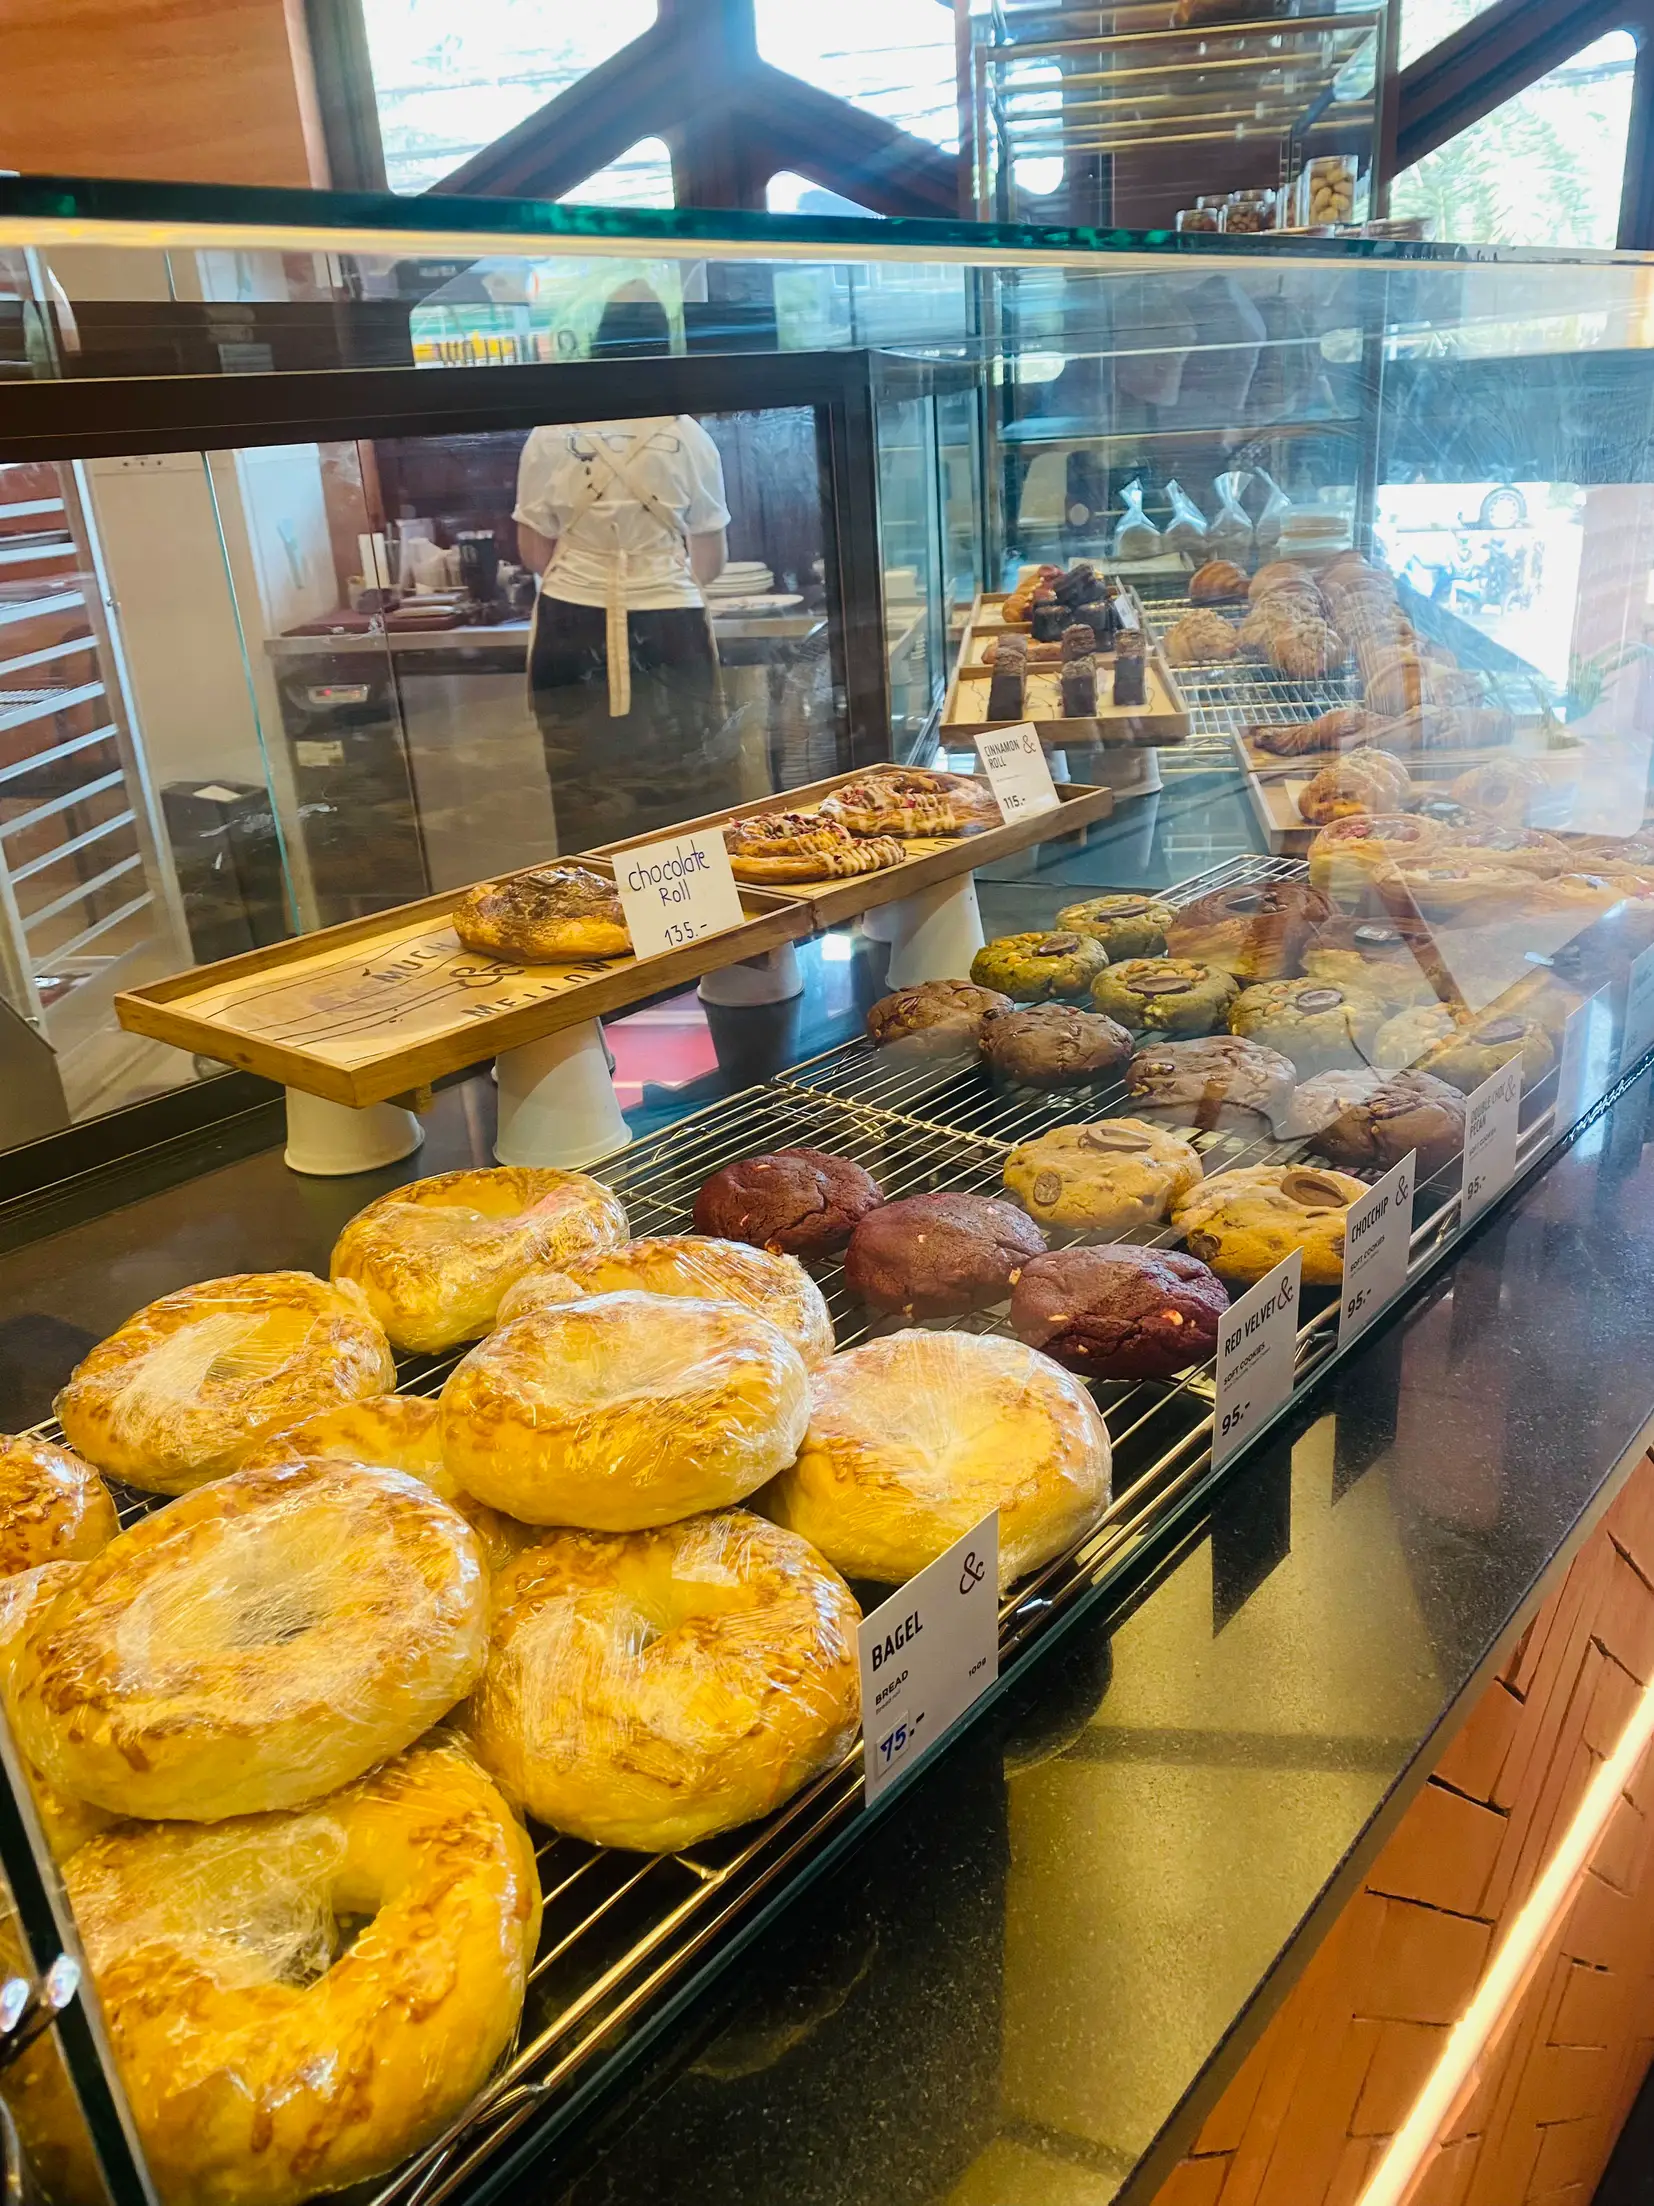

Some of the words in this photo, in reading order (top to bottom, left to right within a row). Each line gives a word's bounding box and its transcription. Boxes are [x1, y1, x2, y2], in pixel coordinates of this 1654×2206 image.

[984, 739, 1020, 757] CINNAMON
[1022, 735, 1037, 754] &
[989, 756, 1007, 770] ROLL
[1003, 795, 1026, 809] 115.-
[659, 879, 691, 907] Roll
[371, 942, 457, 983] MUCH
[1394, 1175, 1409, 1207] &
[1351, 1196, 1389, 1244] CHOCCHIP
[1277, 1275, 1293, 1312] &
[1347, 1288, 1372, 1319] 95.-
[1224, 1327, 1242, 1358] RED
[1245, 1296, 1276, 1337] VELVET
[1224, 1365, 1239, 1386] SOFT
[1240, 1341, 1265, 1370] COOKIES
[1222, 1401, 1250, 1436] 95.-
[959, 1551, 985, 1595] &
[872, 1610, 923, 1672] BAGEL
[968, 1656, 987, 1678] 100g
[875, 1669, 909, 1706] BREAD
[879, 1711, 925, 1763] 75.-
